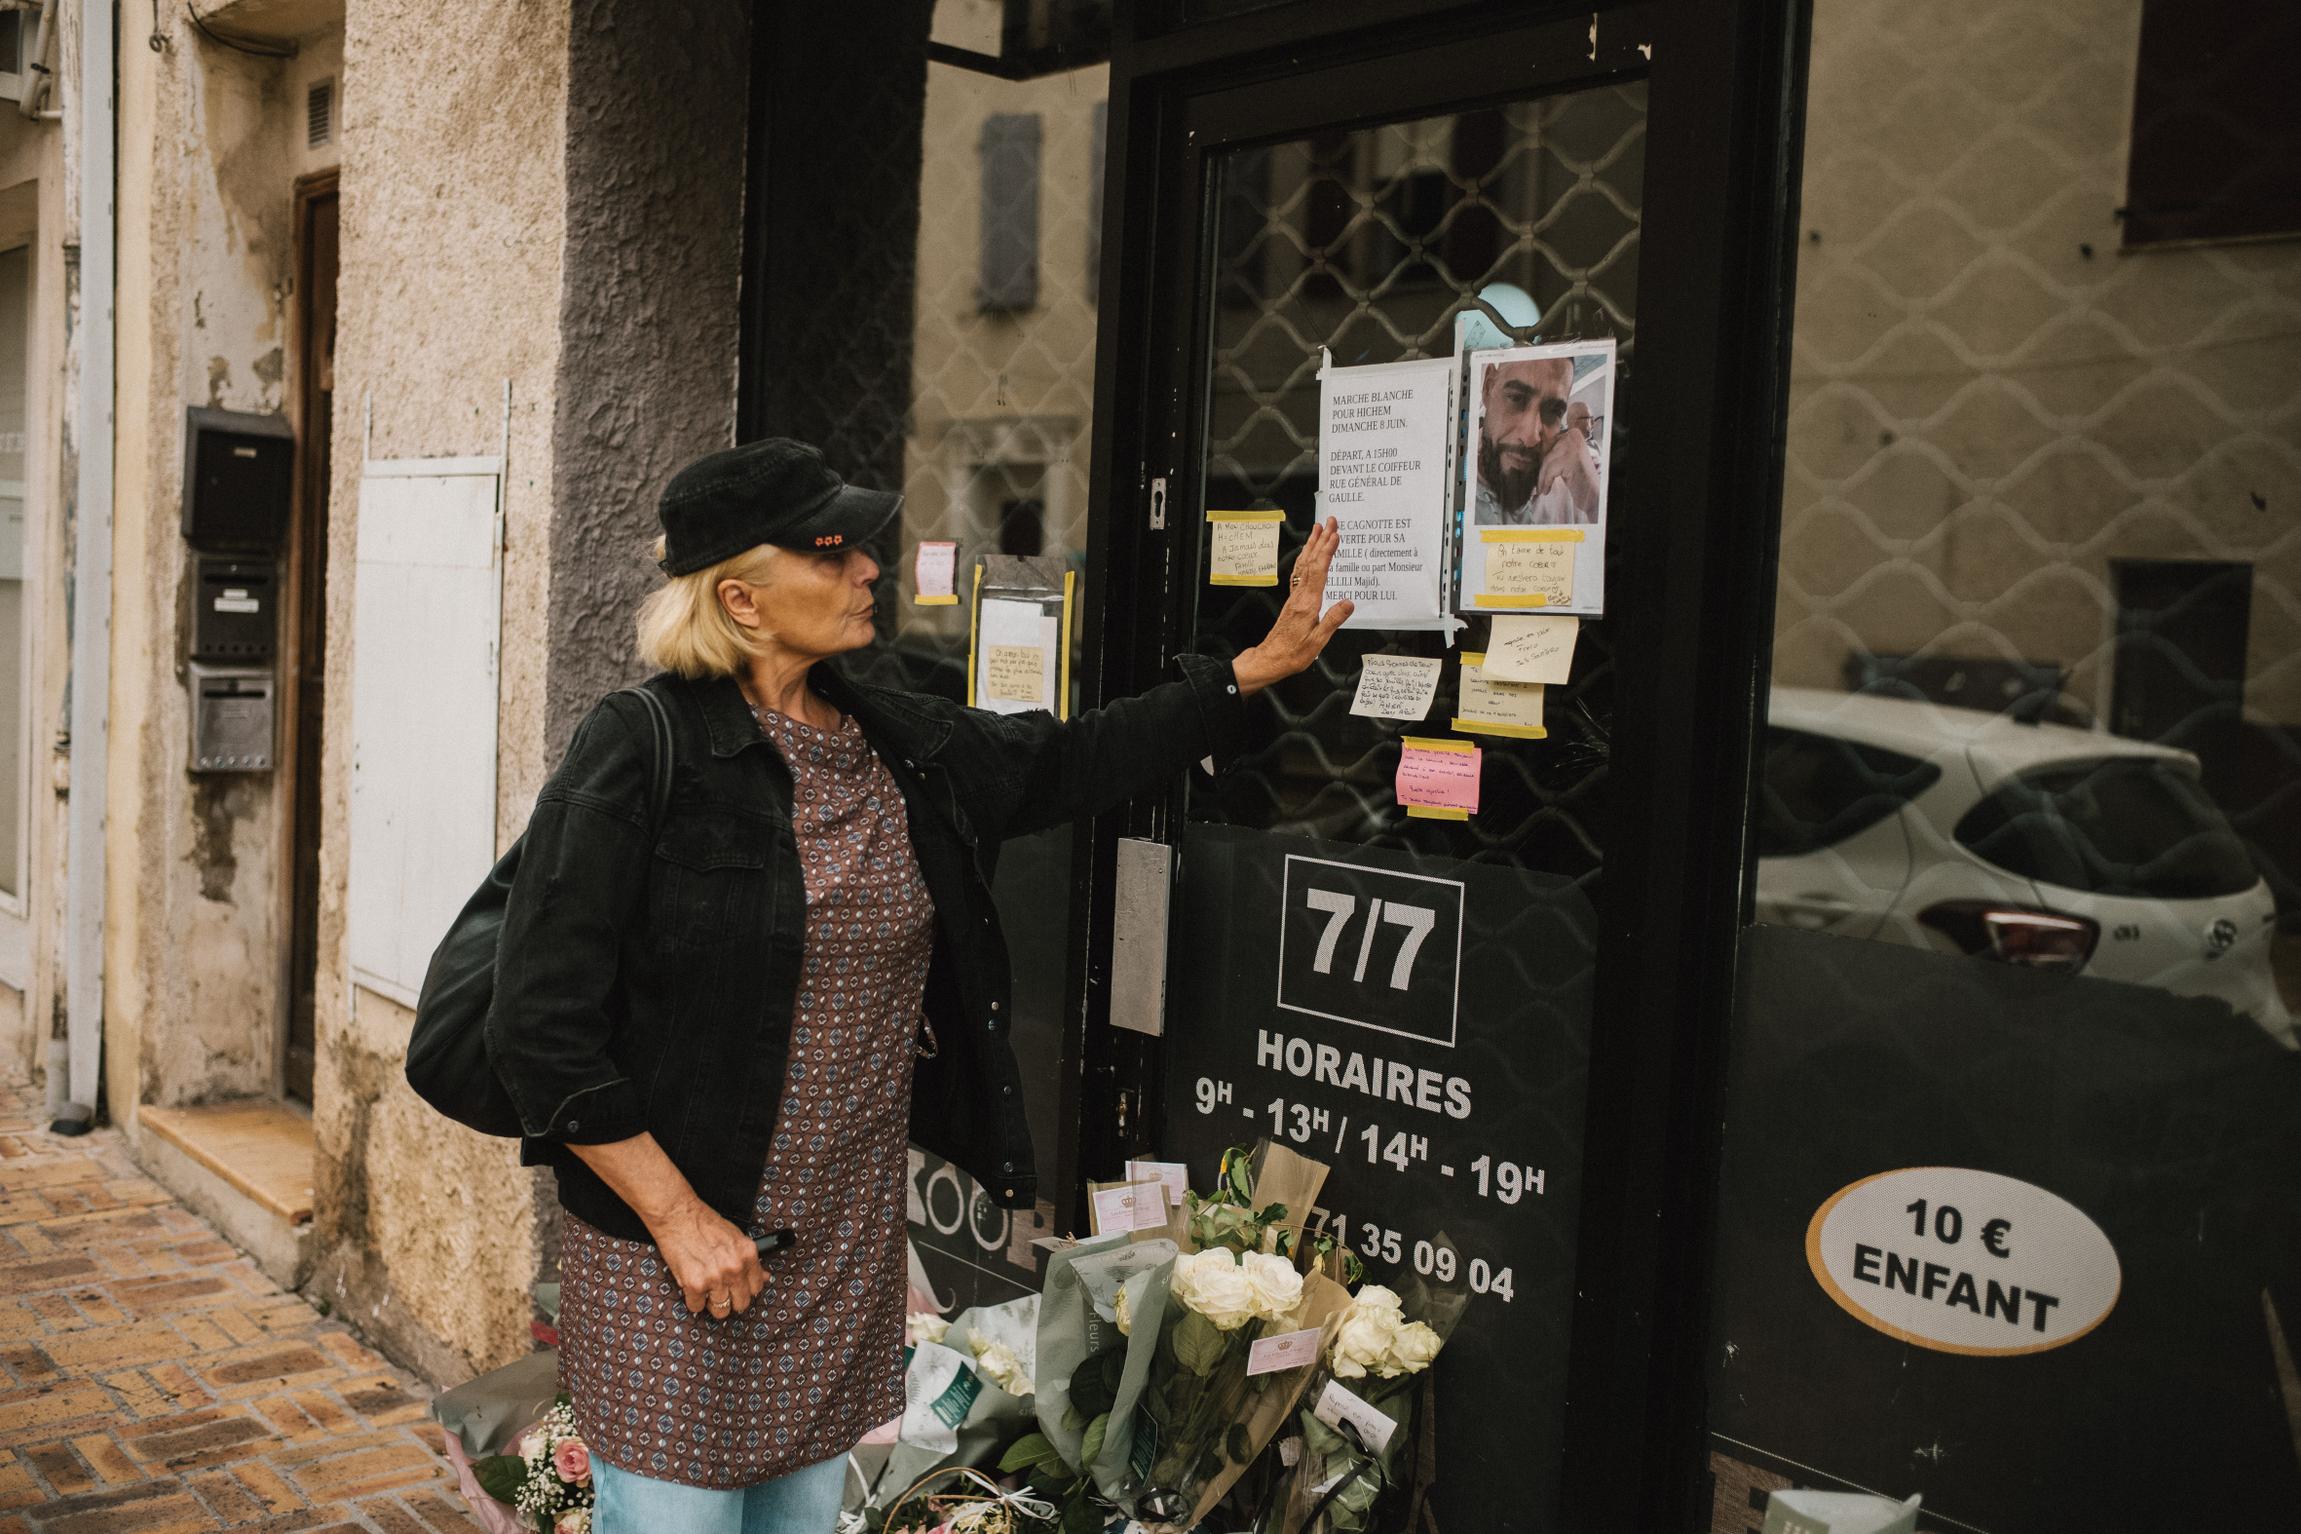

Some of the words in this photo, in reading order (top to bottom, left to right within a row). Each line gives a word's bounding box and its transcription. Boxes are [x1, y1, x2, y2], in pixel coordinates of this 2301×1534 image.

[1333, 393, 1369, 405] MARCHE
[1371, 389, 1414, 402] BLANCHE
[1332, 408, 1355, 420] POUR
[1356, 406, 1391, 417] HICHEM
[1331, 421, 1378, 433] DIMANCHE
[1380, 420, 1385, 429] 8
[1330, 449, 1364, 461] DÉPART,
[1374, 448, 1398, 458] 15H00
[1330, 464, 1364, 475] DEVANT
[1366, 463, 1376, 473] LE
[1378, 460, 1421, 472] COIFFEUR
[1329, 479, 1346, 489] RUE
[1347, 475, 1388, 488] GÉNÉRAL
[1390, 476, 1402, 486] DE
[1347, 519, 1393, 530] CAGNOTTE
[1395, 518, 1412, 529] EST
[1339, 534, 1367, 544] VERTE
[1368, 533, 1391, 544] POUR
[1393, 533, 1406, 543] SA
[1333, 548, 1363, 559] AMILLE
[1369, 548, 1412, 558] directement
[1335, 562, 1360, 572] famille
[1361, 564, 1371, 572] ou
[1372, 563, 1386, 574] part
[1388, 562, 1423, 572] Monsieur
[1325, 591, 1352, 600] MERCI
[1354, 591, 1378, 600] POUR
[1306, 887, 1436, 991] 7/7
[1257, 1028, 1473, 1120] HORAIRES
[1195, 1077, 1233, 1115] 9H
[1267, 1097, 1330, 1143] 13H
[1361, 1124, 1429, 1173] 14H
[1470, 1154, 1545, 1206] 19H
[1906, 1198, 1963, 1245] 10
[1980, 1218, 2012, 1259] €
[1360, 1222, 1402, 1264] 35
[1413, 1239, 1457, 1283] 09
[1468, 1257, 1514, 1303] 04
[1853, 1243, 2060, 1334] ENFANT
